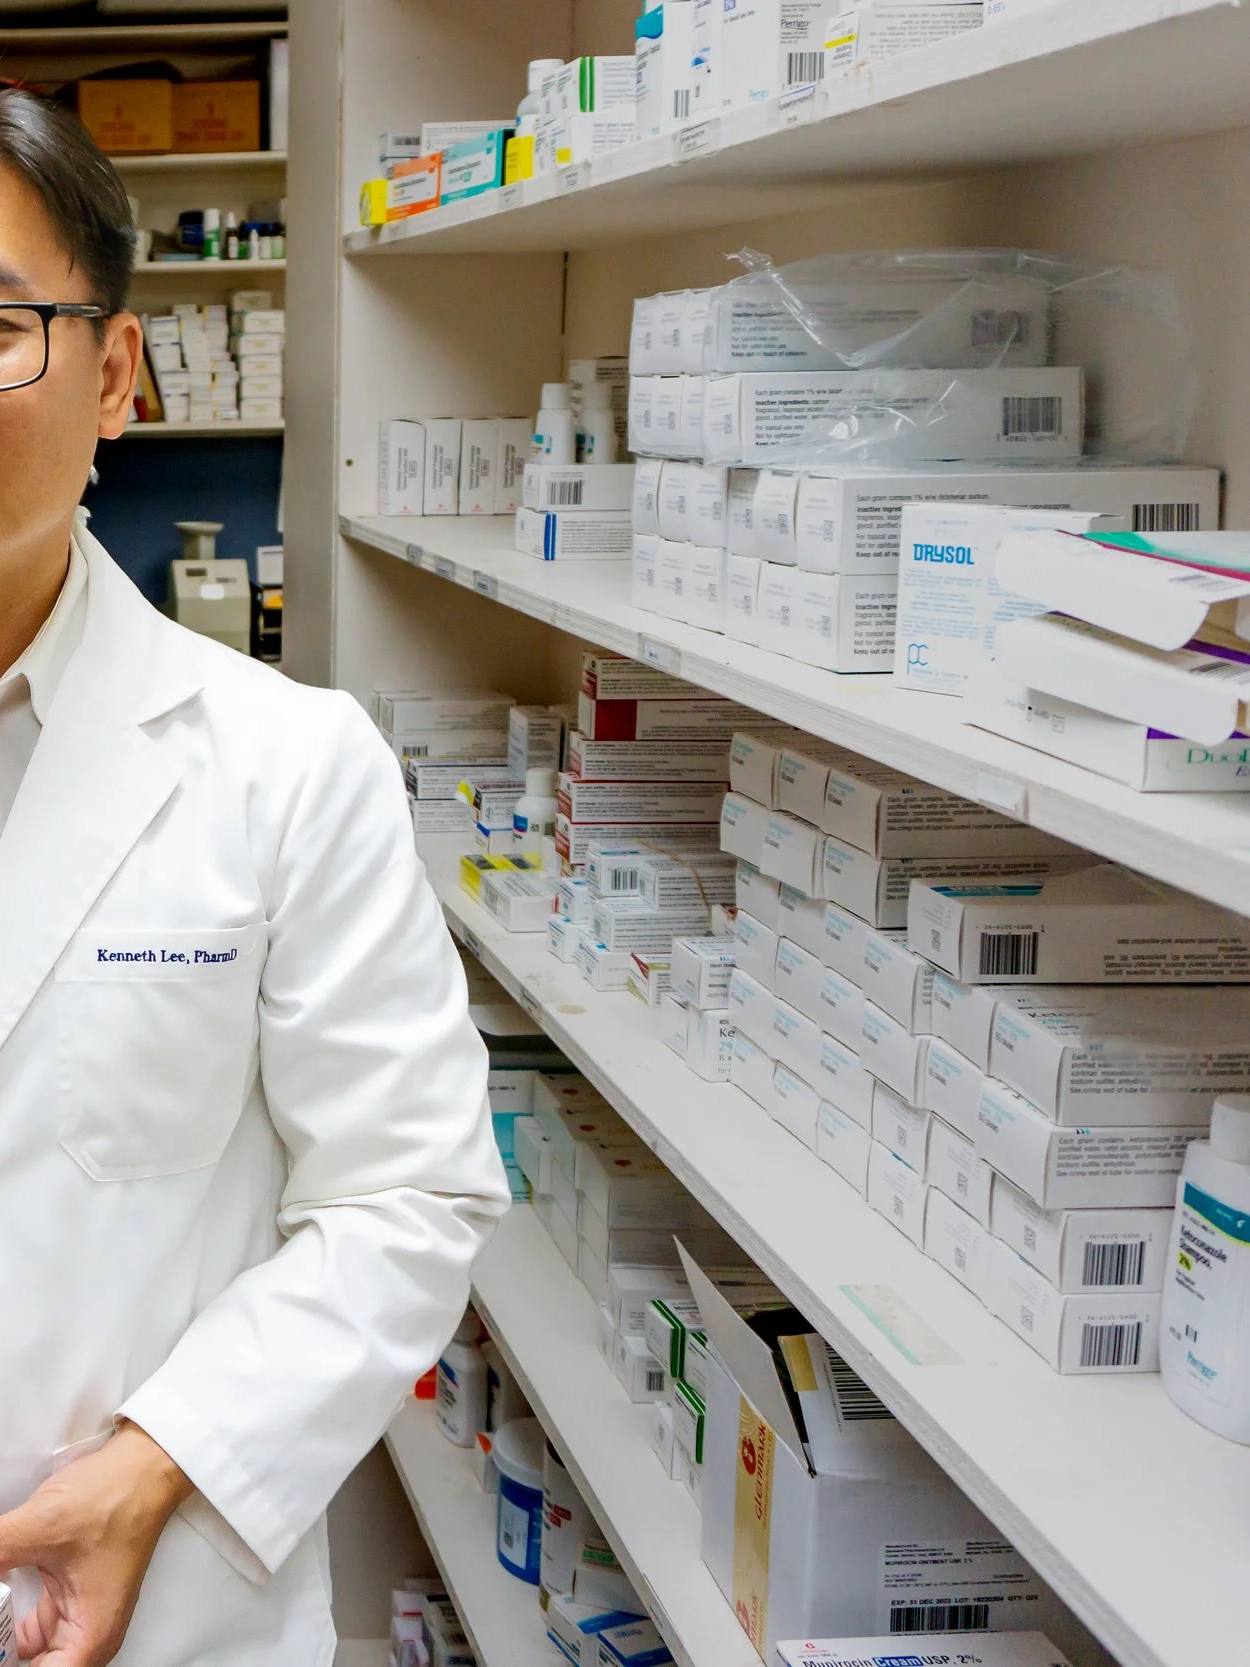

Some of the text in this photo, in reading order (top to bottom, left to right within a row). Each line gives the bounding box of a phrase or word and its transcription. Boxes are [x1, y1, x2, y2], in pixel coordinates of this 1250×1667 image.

[913, 543, 974, 565] DRYSOL
[97, 949, 237, 964] Kenneth Lee, PharmD
[876, 1656, 918, 1667] Cream
[957, 1654, 983, 1665] 2%
